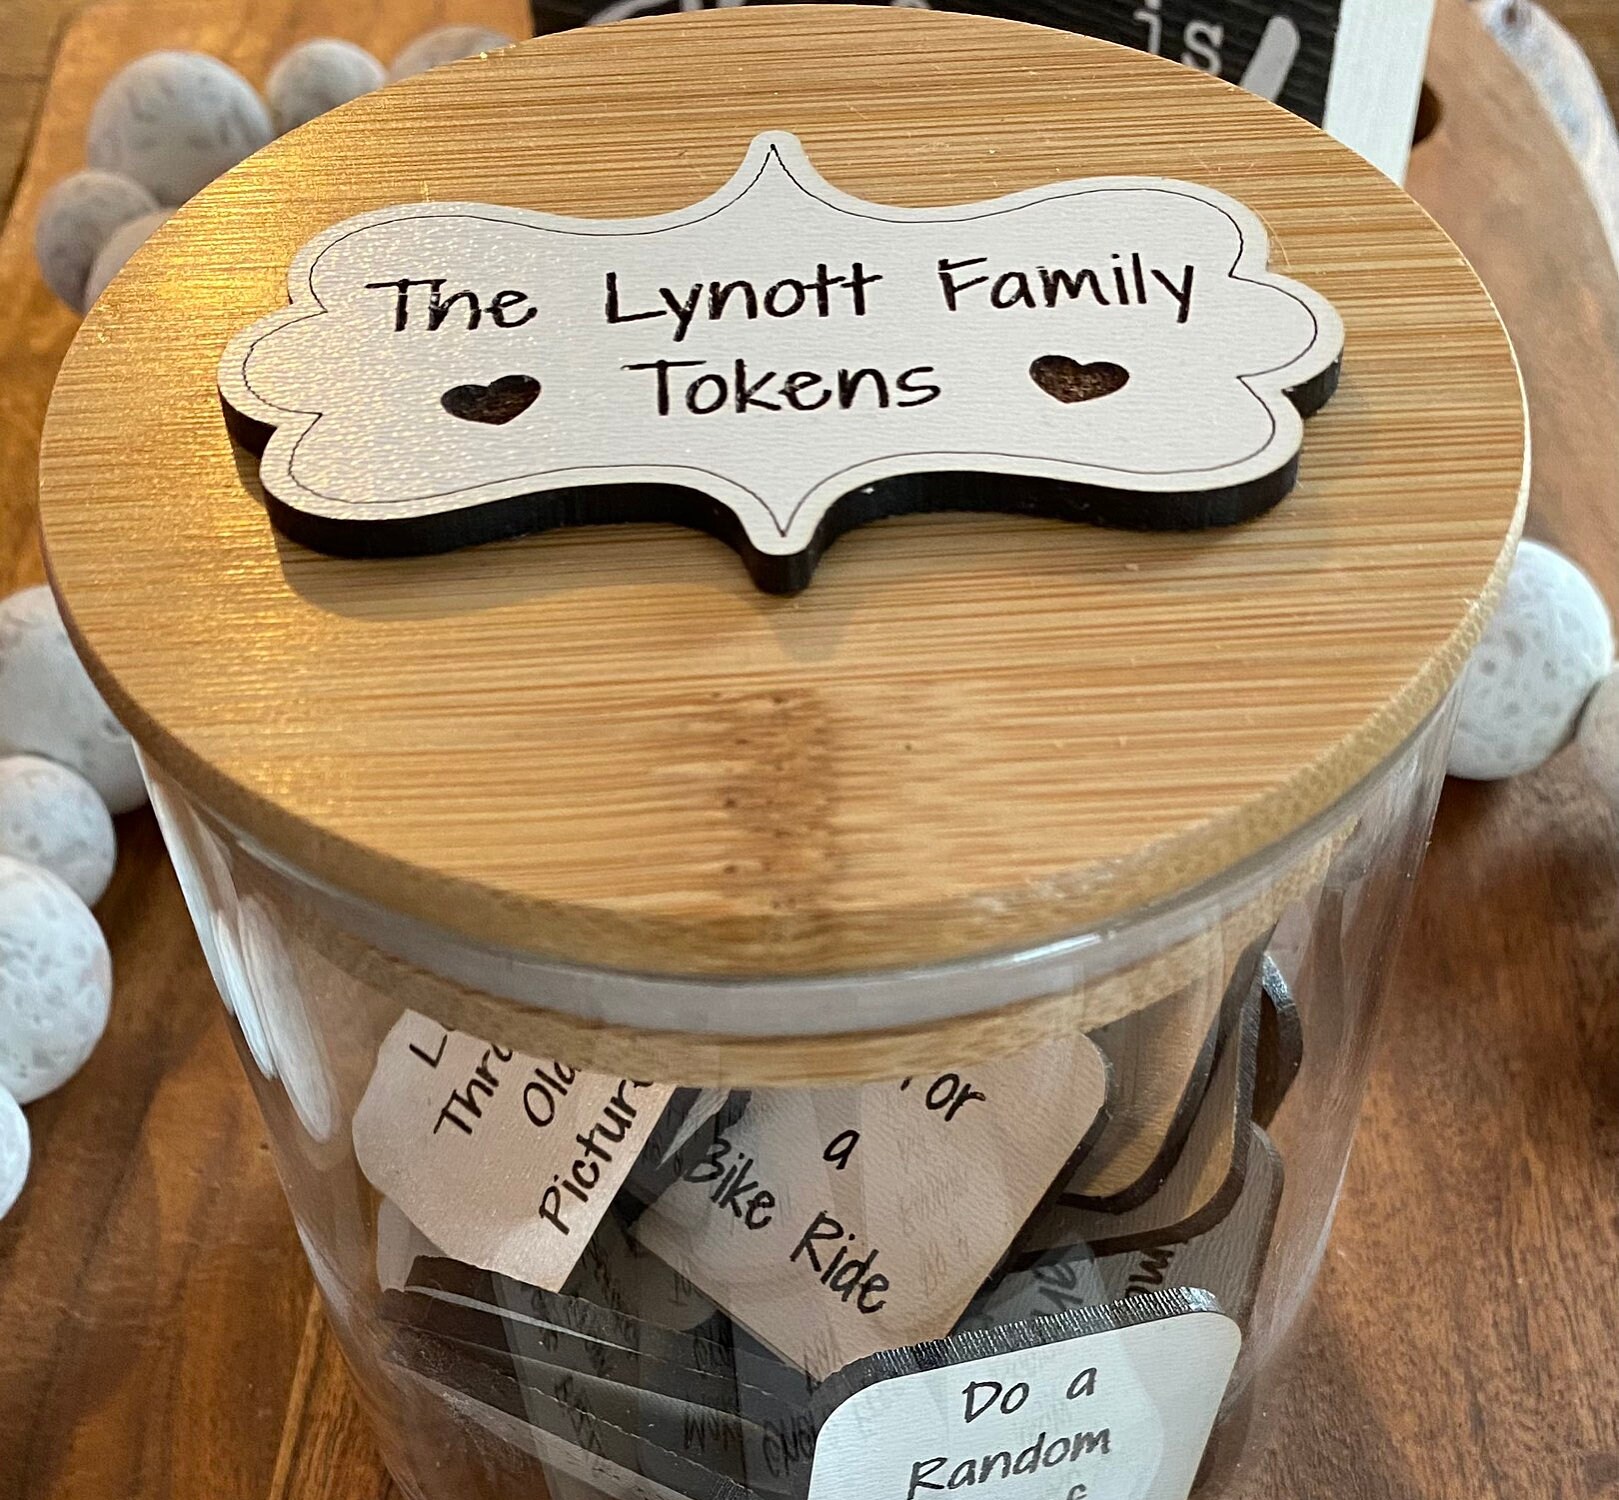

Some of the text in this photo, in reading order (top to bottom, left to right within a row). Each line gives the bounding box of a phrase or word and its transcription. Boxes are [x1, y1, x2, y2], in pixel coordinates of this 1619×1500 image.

[368, 252, 1196, 343] The Lynott Family
[622, 356, 942, 417] Tokens
[901, 1072, 986, 1121] or
[538, 1078, 655, 1235] Pictur
[684, 1136, 776, 1230] Bike
[823, 1129, 860, 1170] a
[789, 1210, 891, 1314] Ride
[962, 1366, 1098, 1423] Do a
[906, 1424, 1112, 1500] Random
